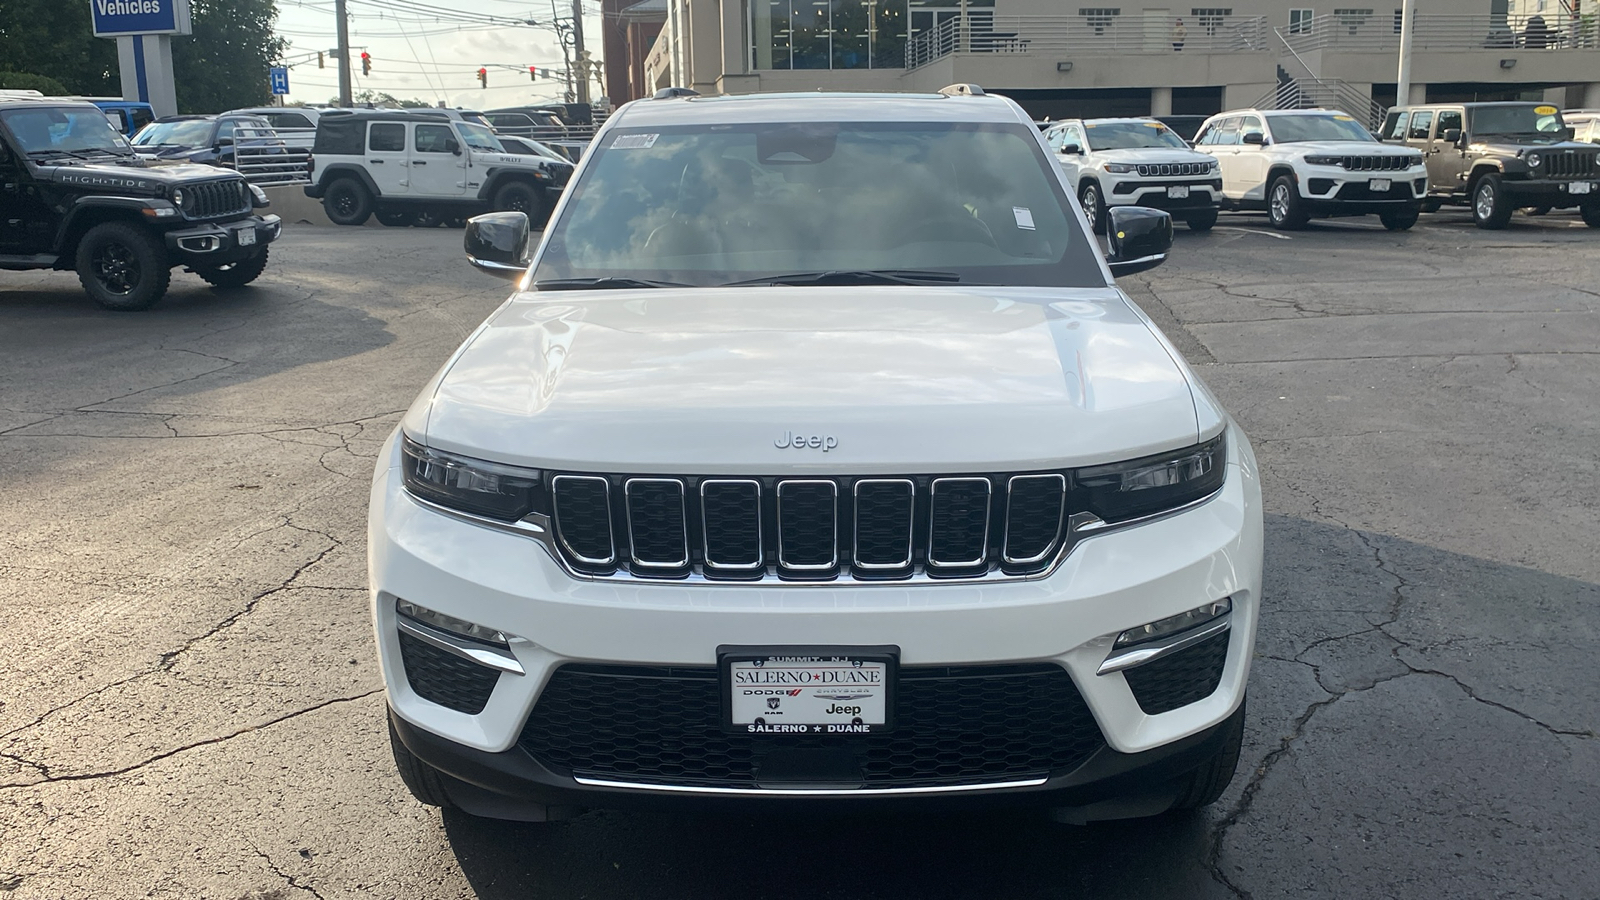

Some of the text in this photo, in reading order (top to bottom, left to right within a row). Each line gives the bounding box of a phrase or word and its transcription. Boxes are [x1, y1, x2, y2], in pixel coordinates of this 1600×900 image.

[97, 0, 161, 16] Vehicles
[275, 74, 286, 87] H
[62, 175, 146, 188] HIGH TIDE
[774, 430, 838, 453] Jeep
[735, 671, 880, 683] SALERNO DUANE
[825, 703, 861, 716] Jeep
[747, 724, 870, 733] SALERNO DUANE
